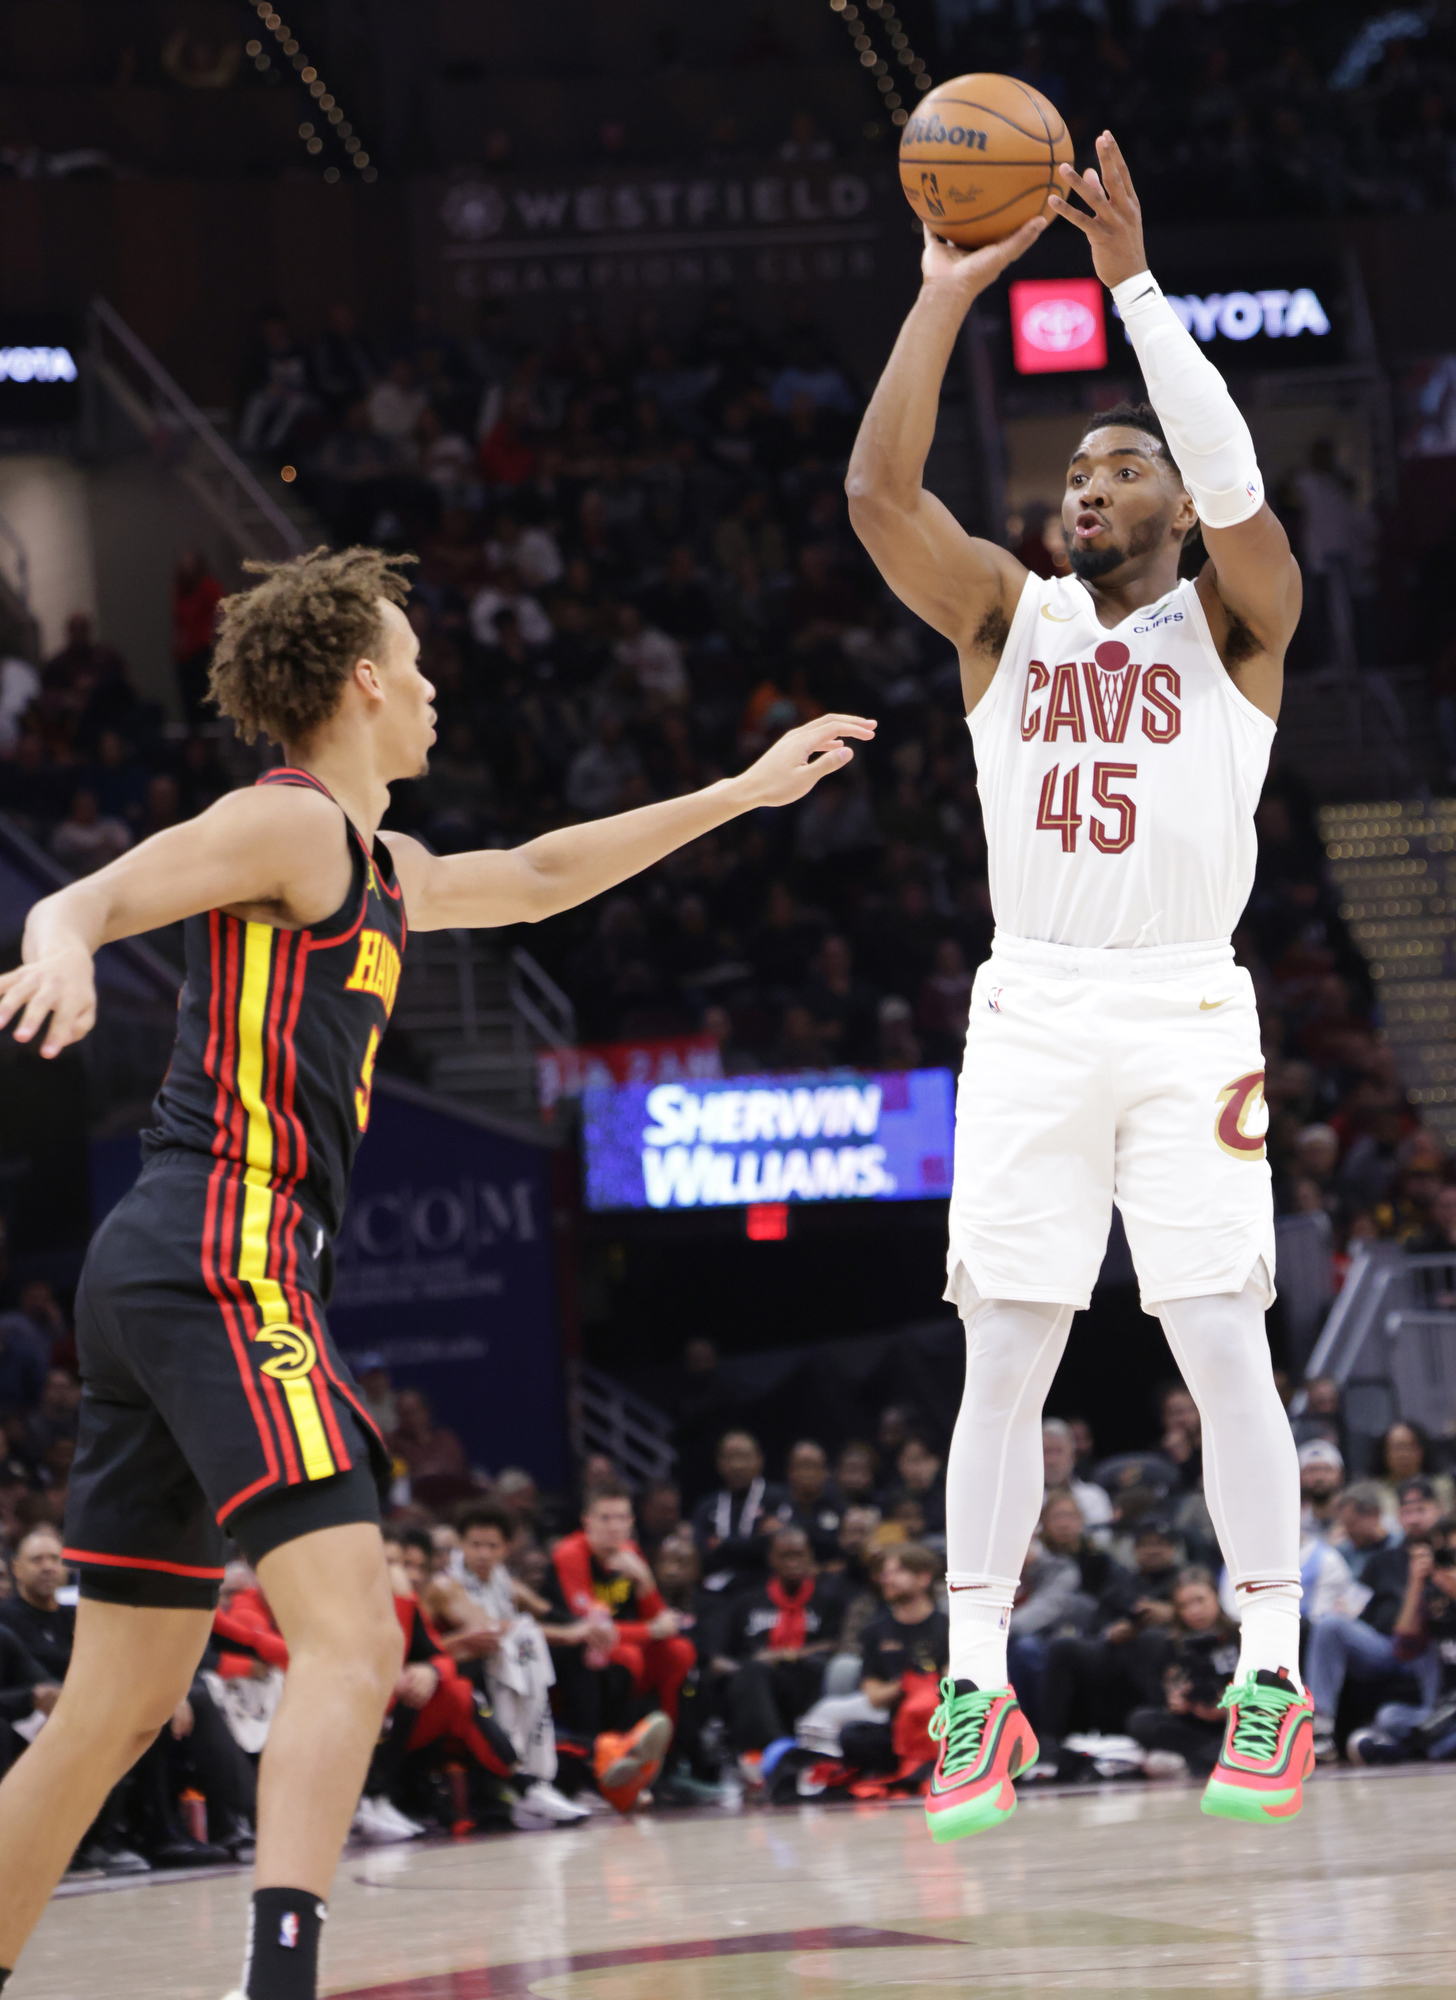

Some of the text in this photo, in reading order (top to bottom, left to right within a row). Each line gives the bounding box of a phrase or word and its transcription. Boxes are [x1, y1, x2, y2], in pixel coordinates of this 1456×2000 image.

[513, 173, 870, 231] WESTFIELD
[1112, 289, 1331, 346] YOTA
[1133, 612, 1184, 634] CLIFFS
[1021, 660, 1182, 745] CAVS
[1036, 761, 1138, 854] 45
[641, 1083, 882, 1147] SHERWIN
[641, 1144, 890, 1208] WILLIAMS
